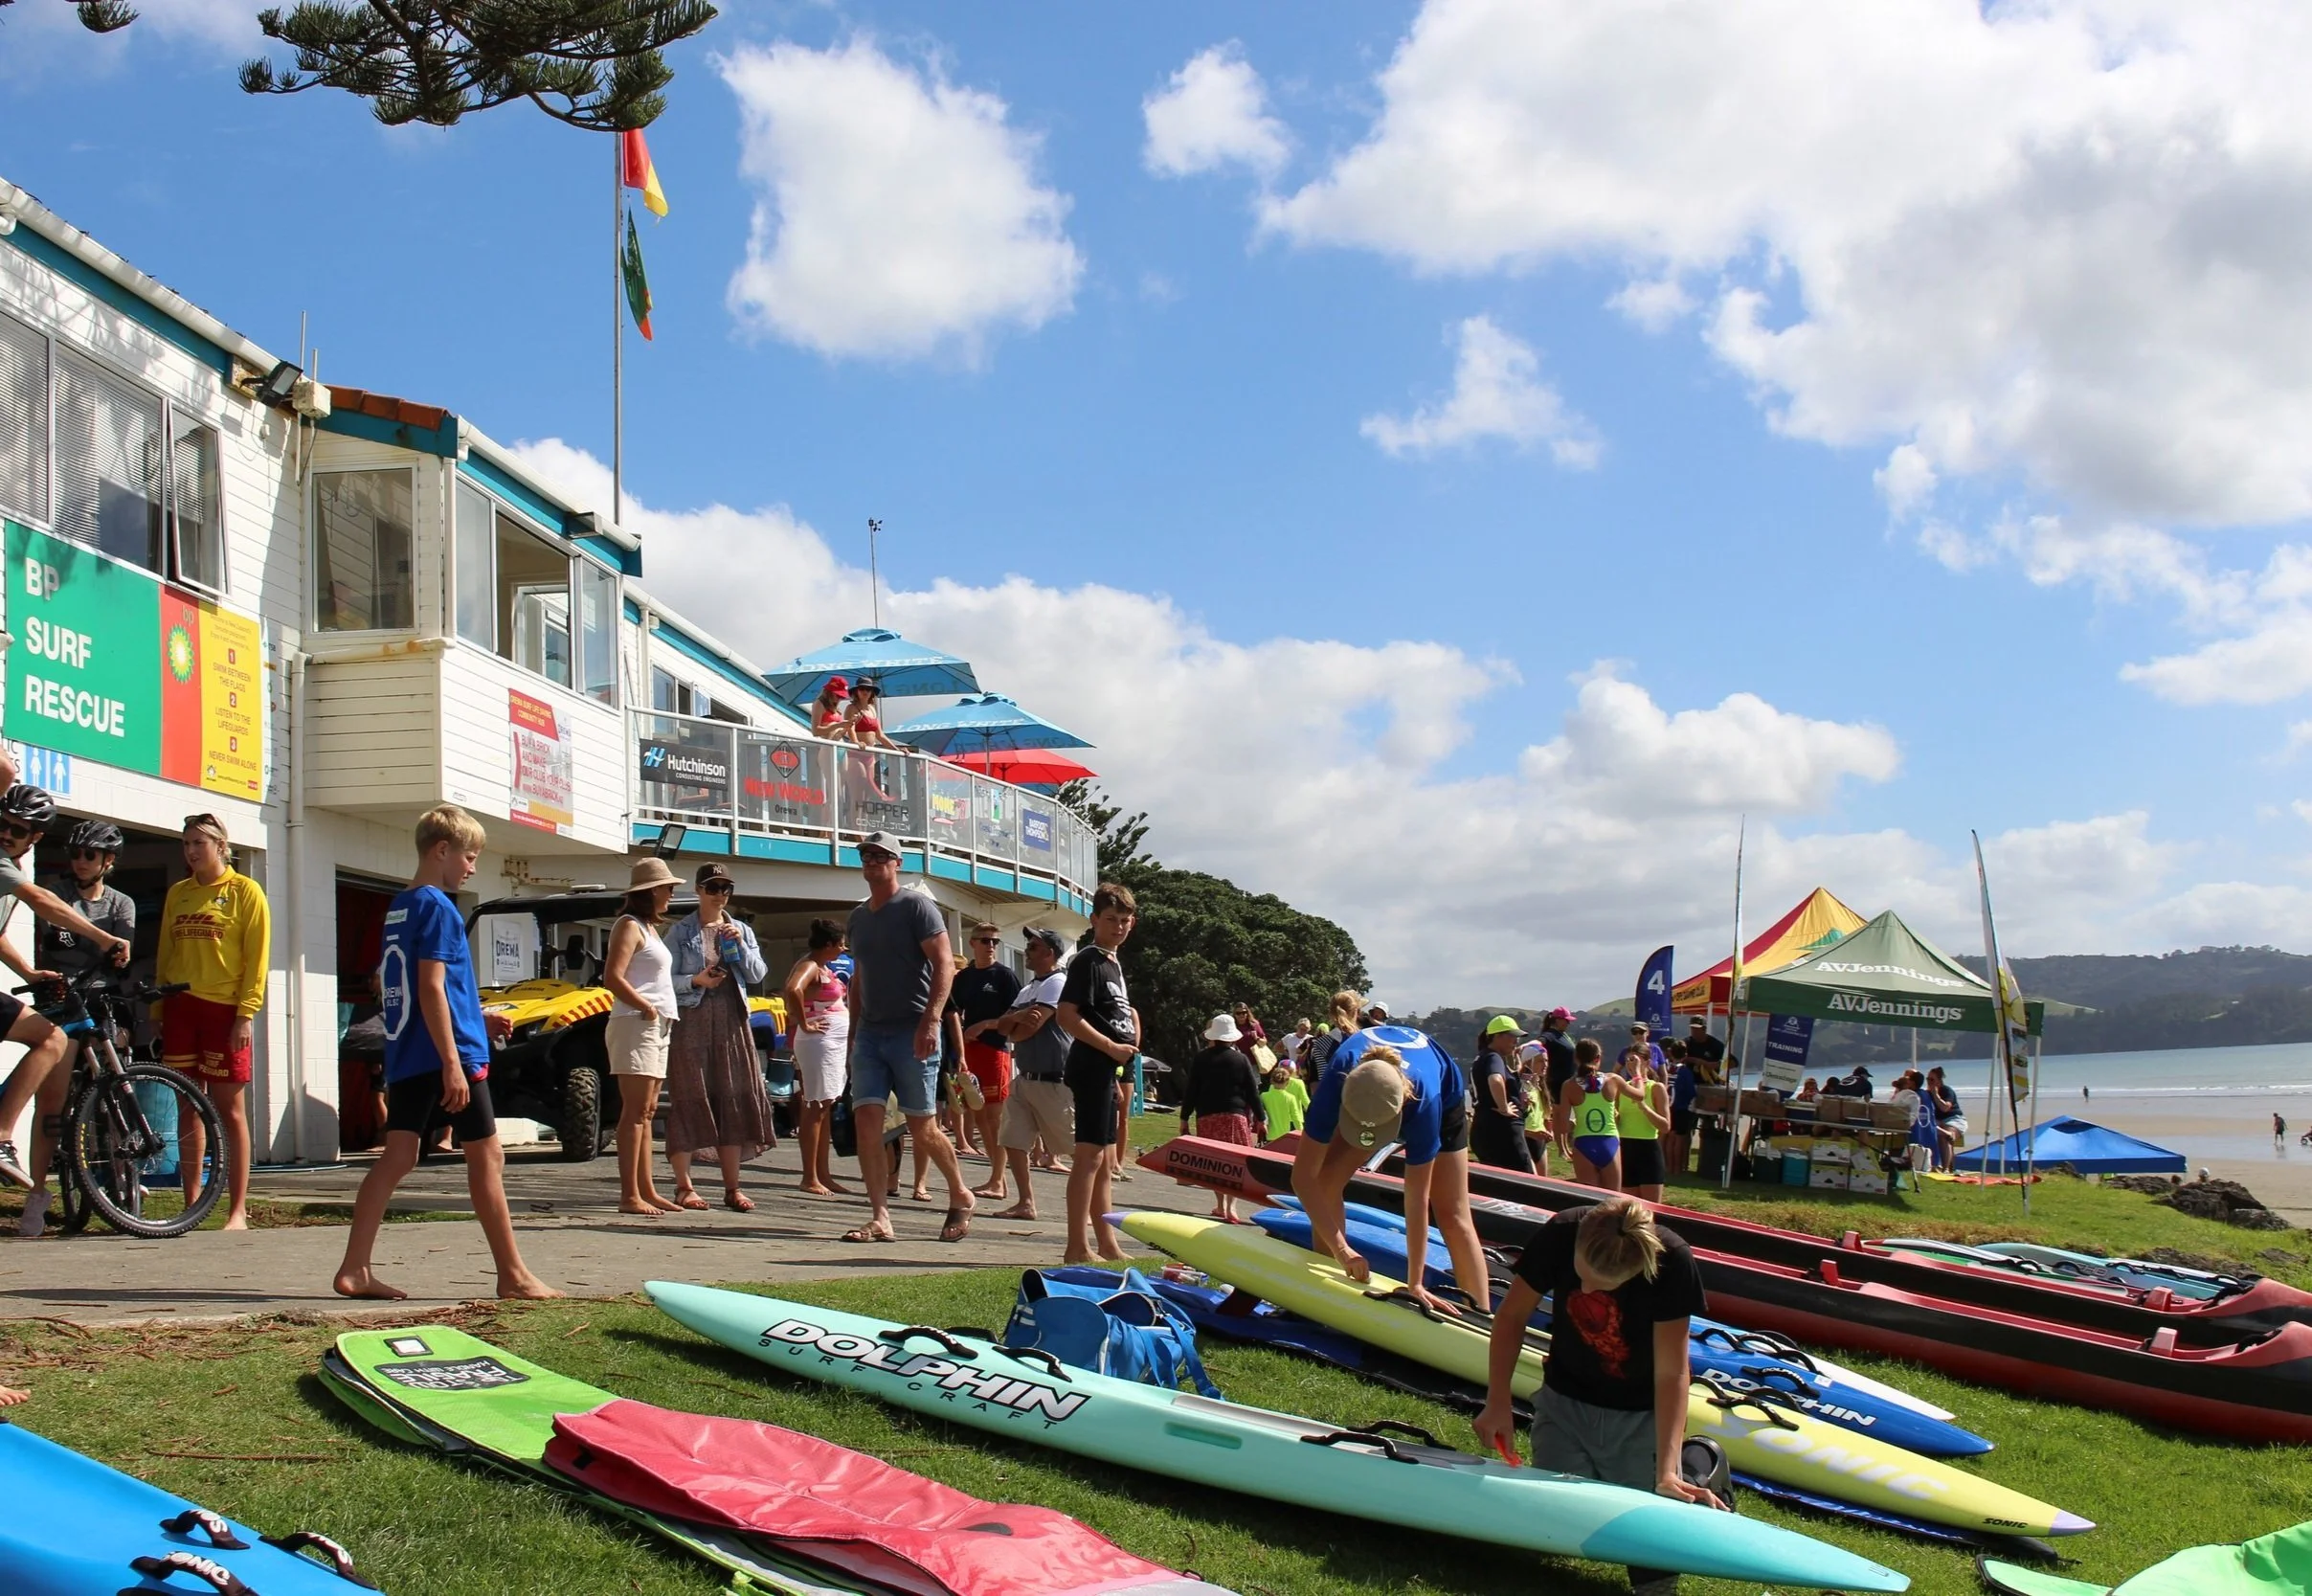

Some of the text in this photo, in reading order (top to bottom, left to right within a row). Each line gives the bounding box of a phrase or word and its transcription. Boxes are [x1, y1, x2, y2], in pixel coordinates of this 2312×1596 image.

[25, 558, 60, 600] BP
[25, 617, 93, 669] SURF
[213, 663, 251, 682] SWIM BETWEEN
[784, 656, 944, 674] LONG WHITE
[219, 676, 246, 692] THE FLAGS
[24, 674, 125, 737] RESCUE
[215, 708, 251, 725] LISTEN TO THE
[895, 718, 1026, 733] LONG WHITE
[218, 720, 249, 735] LIFEGUARDS
[209, 751, 257, 771] NEVER SWIM ALONE
[667, 753, 726, 776] Hutchinson
[676, 772, 726, 784] CONSULTING ENGINEERS
[744, 776, 825, 805] NEW WORLD
[774, 803, 797, 816] Orewa
[855, 801, 909, 818] HOPPER
[176, 913, 214, 926] DHL
[1647, 970, 1665, 995] 4
[1815, 961, 1964, 987] AVJennings
[1827, 993, 1963, 1023] AVJennings
[1768, 1042, 1804, 1053] TRAINING
[199, 1064, 229, 1077] FEGUARD
[1170, 1151, 1243, 1178] DOMINION
[390, 1366, 507, 1382] FRAGILE
[443, 1360, 491, 1373] HANDLE
[761, 1319, 1091, 1422] DOLPHIN
[758, 1338, 1058, 1429] SURF CRAFT
[1701, 1414, 1950, 1501] SONIC
[1983, 1517, 2030, 1530] SONIC
